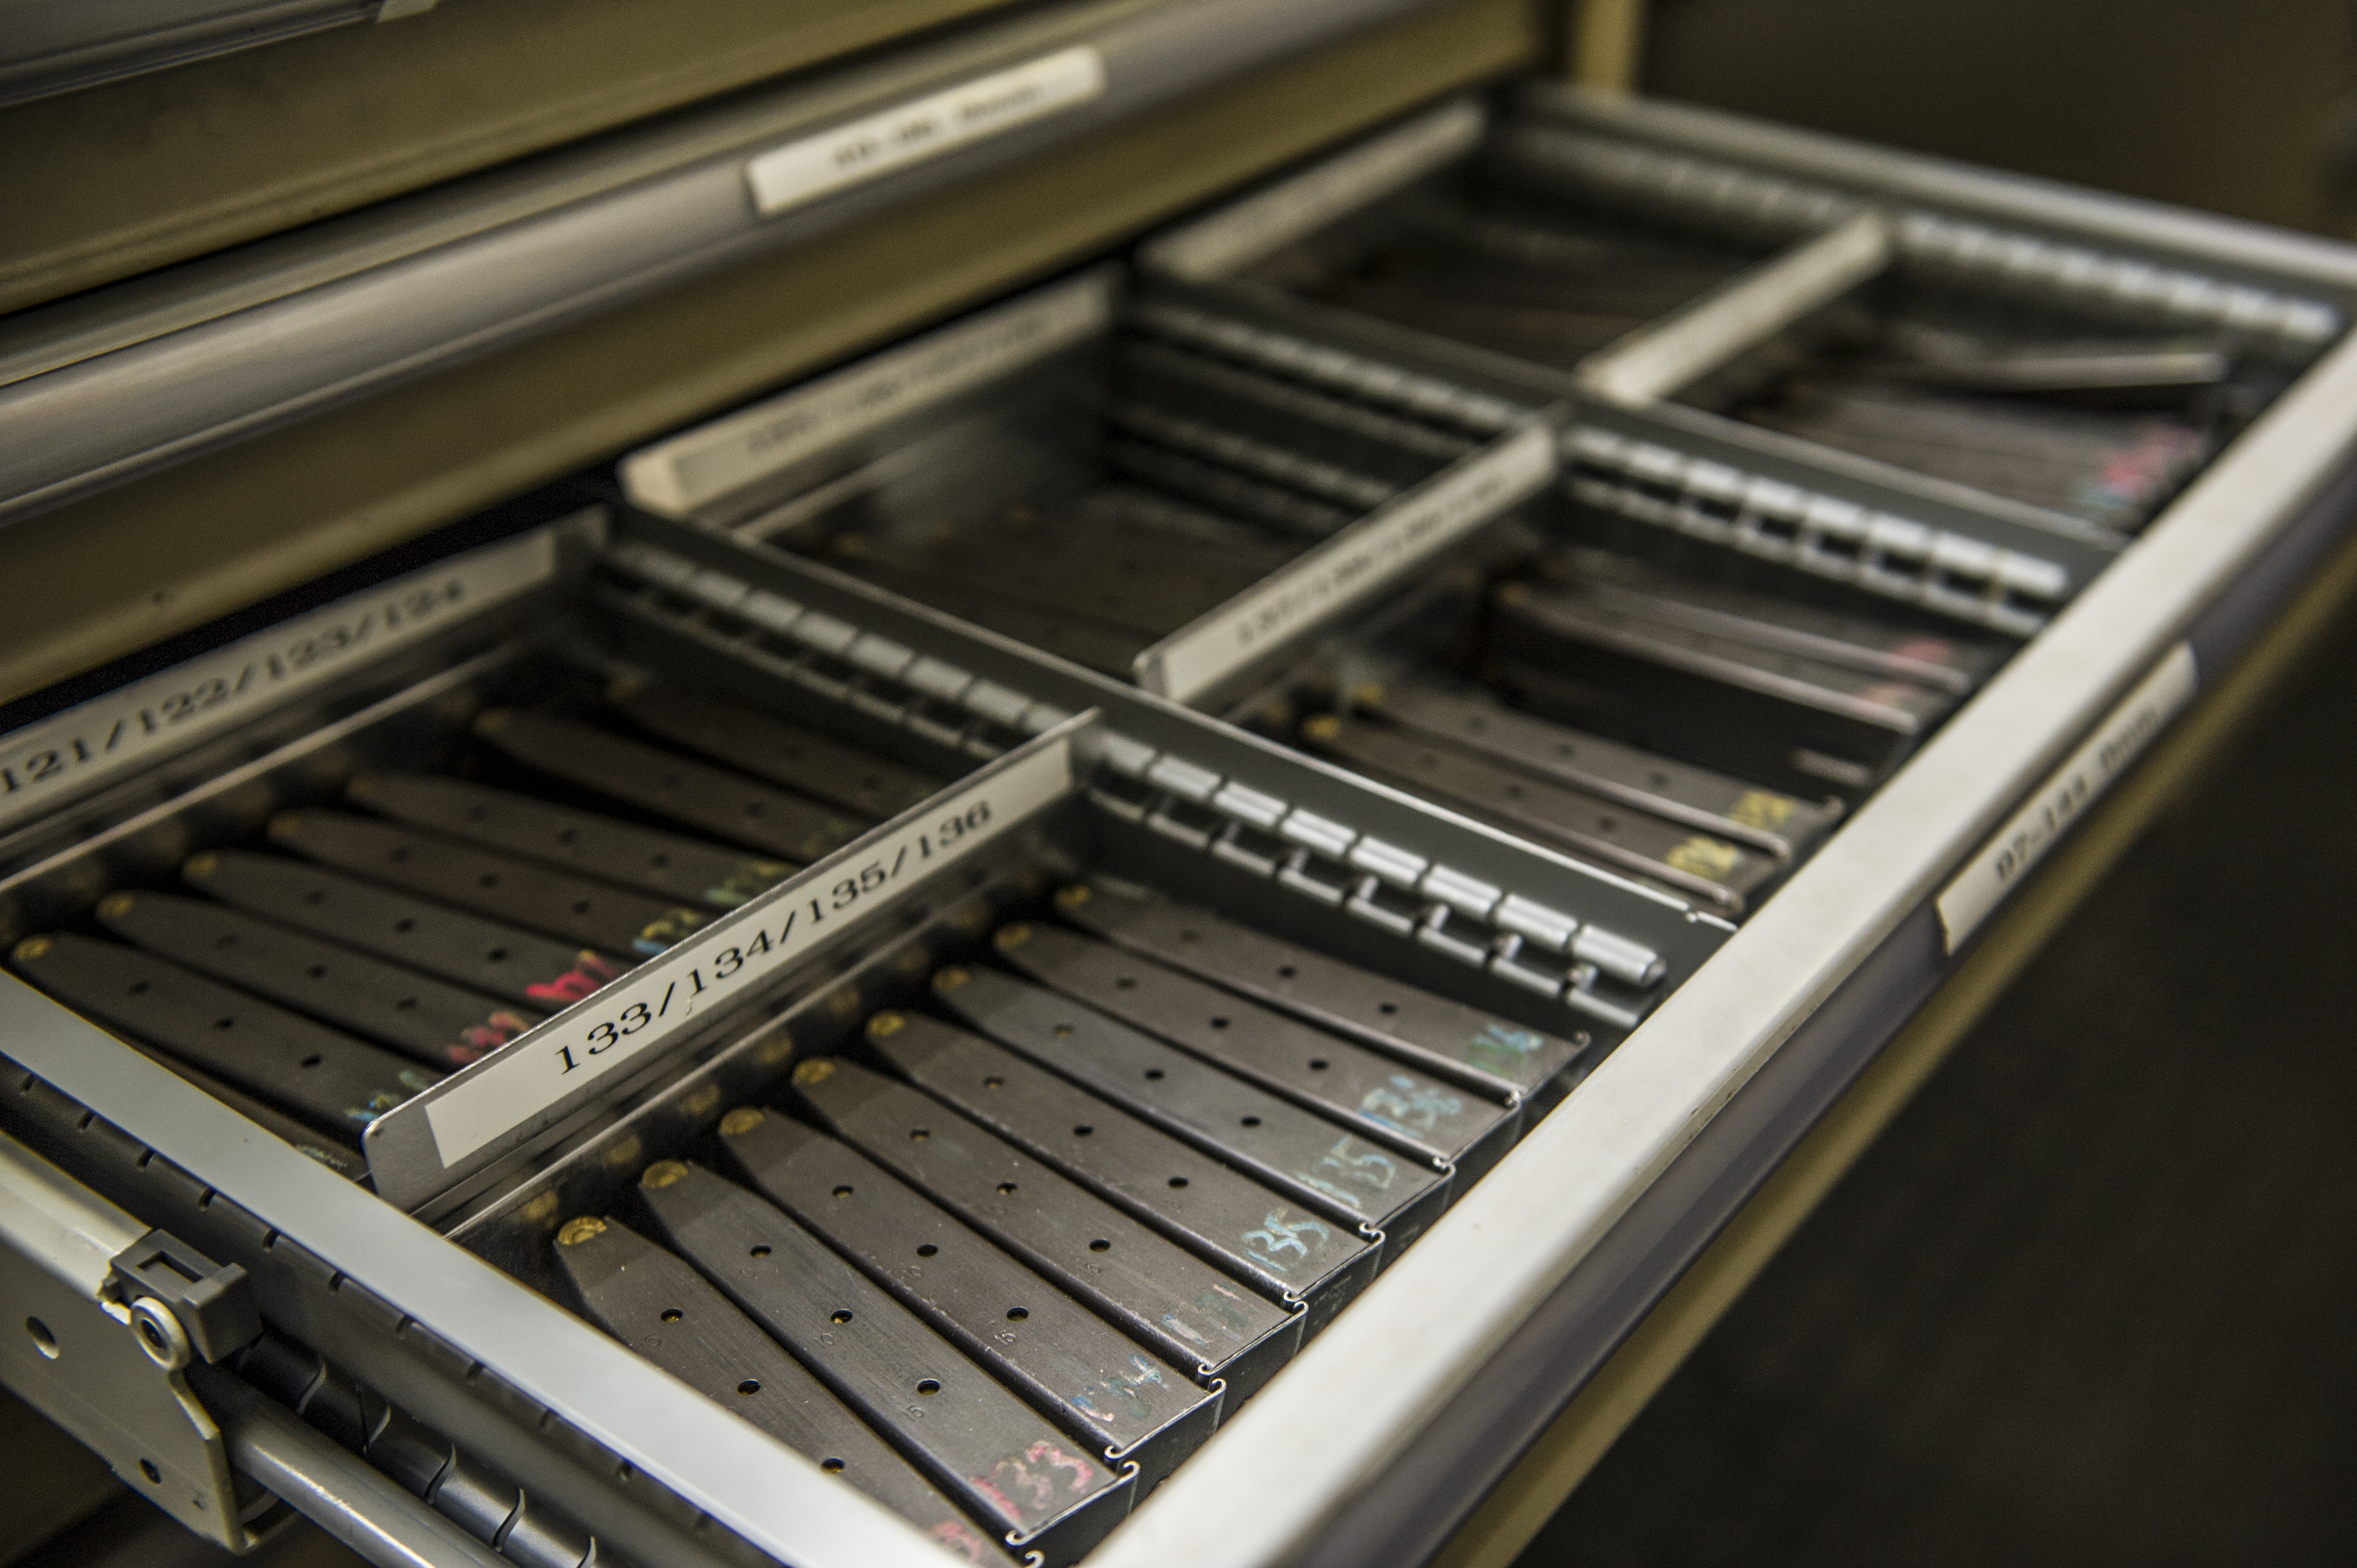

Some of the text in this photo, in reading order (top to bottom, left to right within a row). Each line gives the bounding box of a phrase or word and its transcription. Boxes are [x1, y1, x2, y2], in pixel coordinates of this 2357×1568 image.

[2, 580, 464, 792] 121/122/123/124
[555, 801, 992, 1075] 133/134/135/136
[1241, 1205, 1329, 1272] 135
[969, 1441, 1094, 1518] 133
